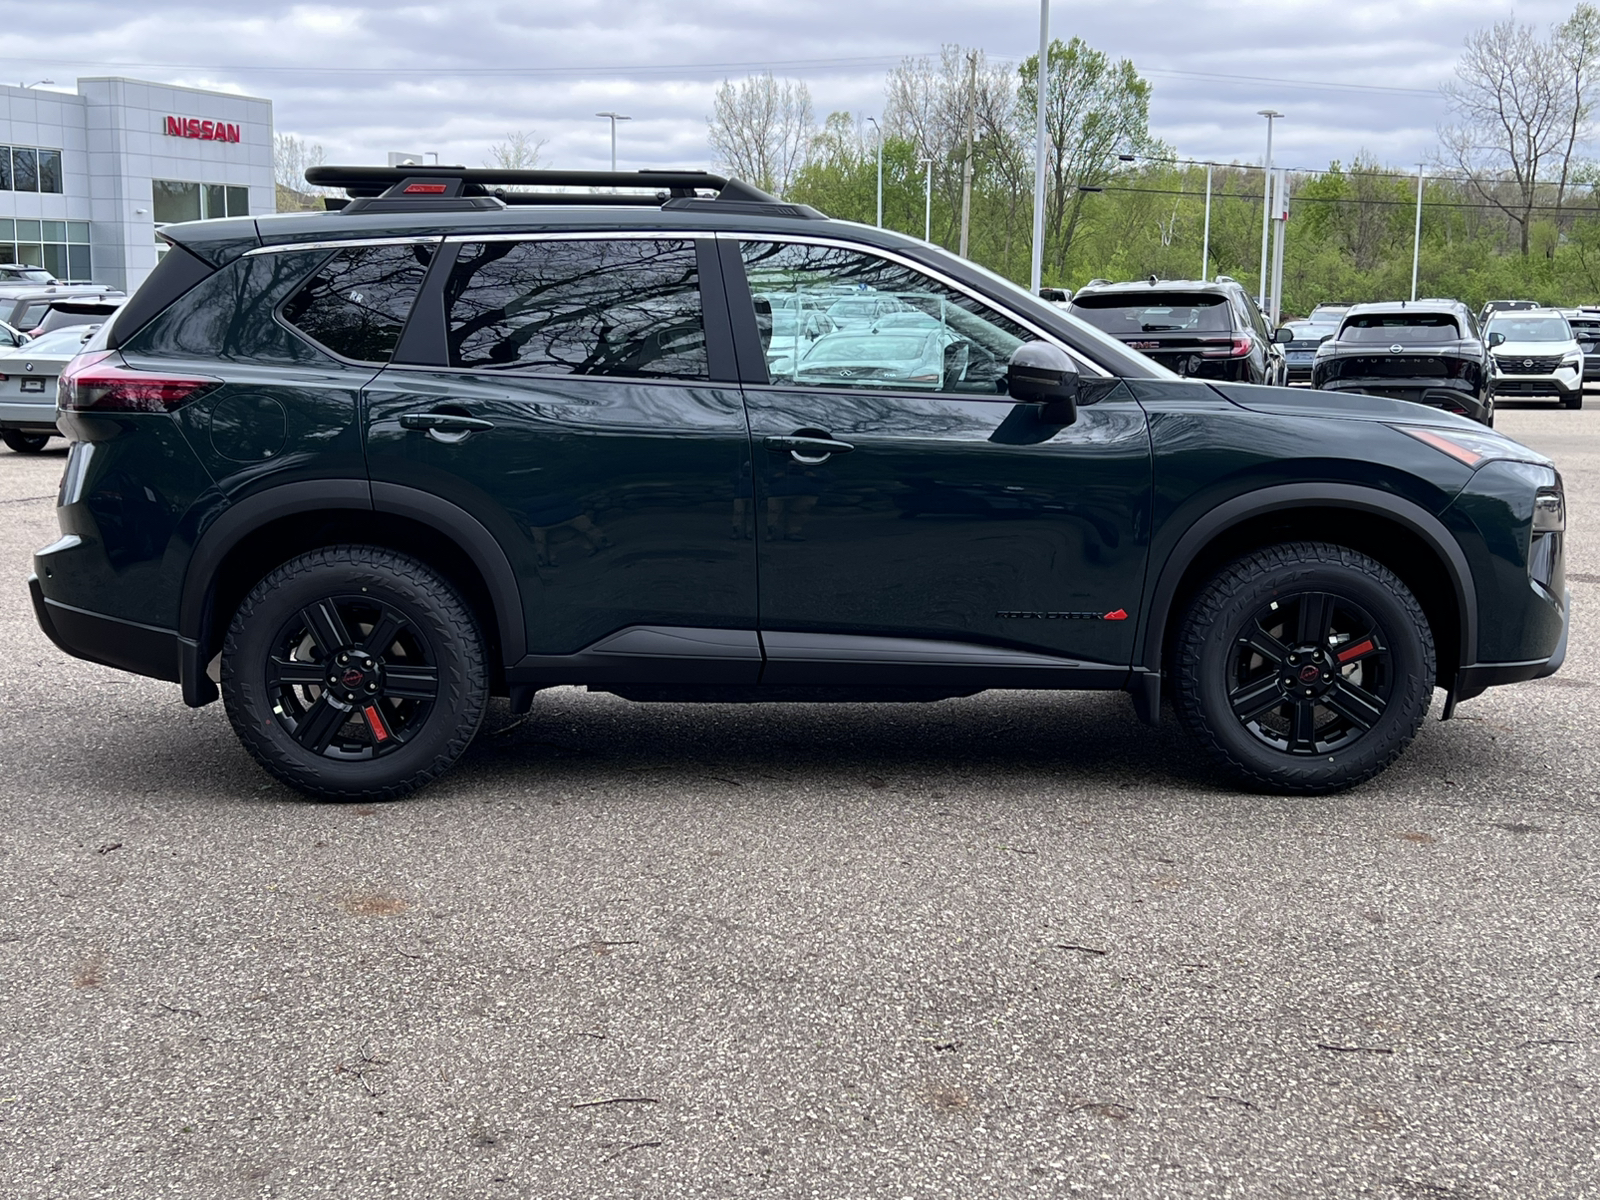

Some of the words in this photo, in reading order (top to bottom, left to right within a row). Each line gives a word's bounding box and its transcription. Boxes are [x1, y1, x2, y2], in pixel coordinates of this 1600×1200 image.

[164, 116, 240, 143] NISSAN
[996, 610, 1044, 619] ROCK
[1046, 611, 1103, 620] CREEK
